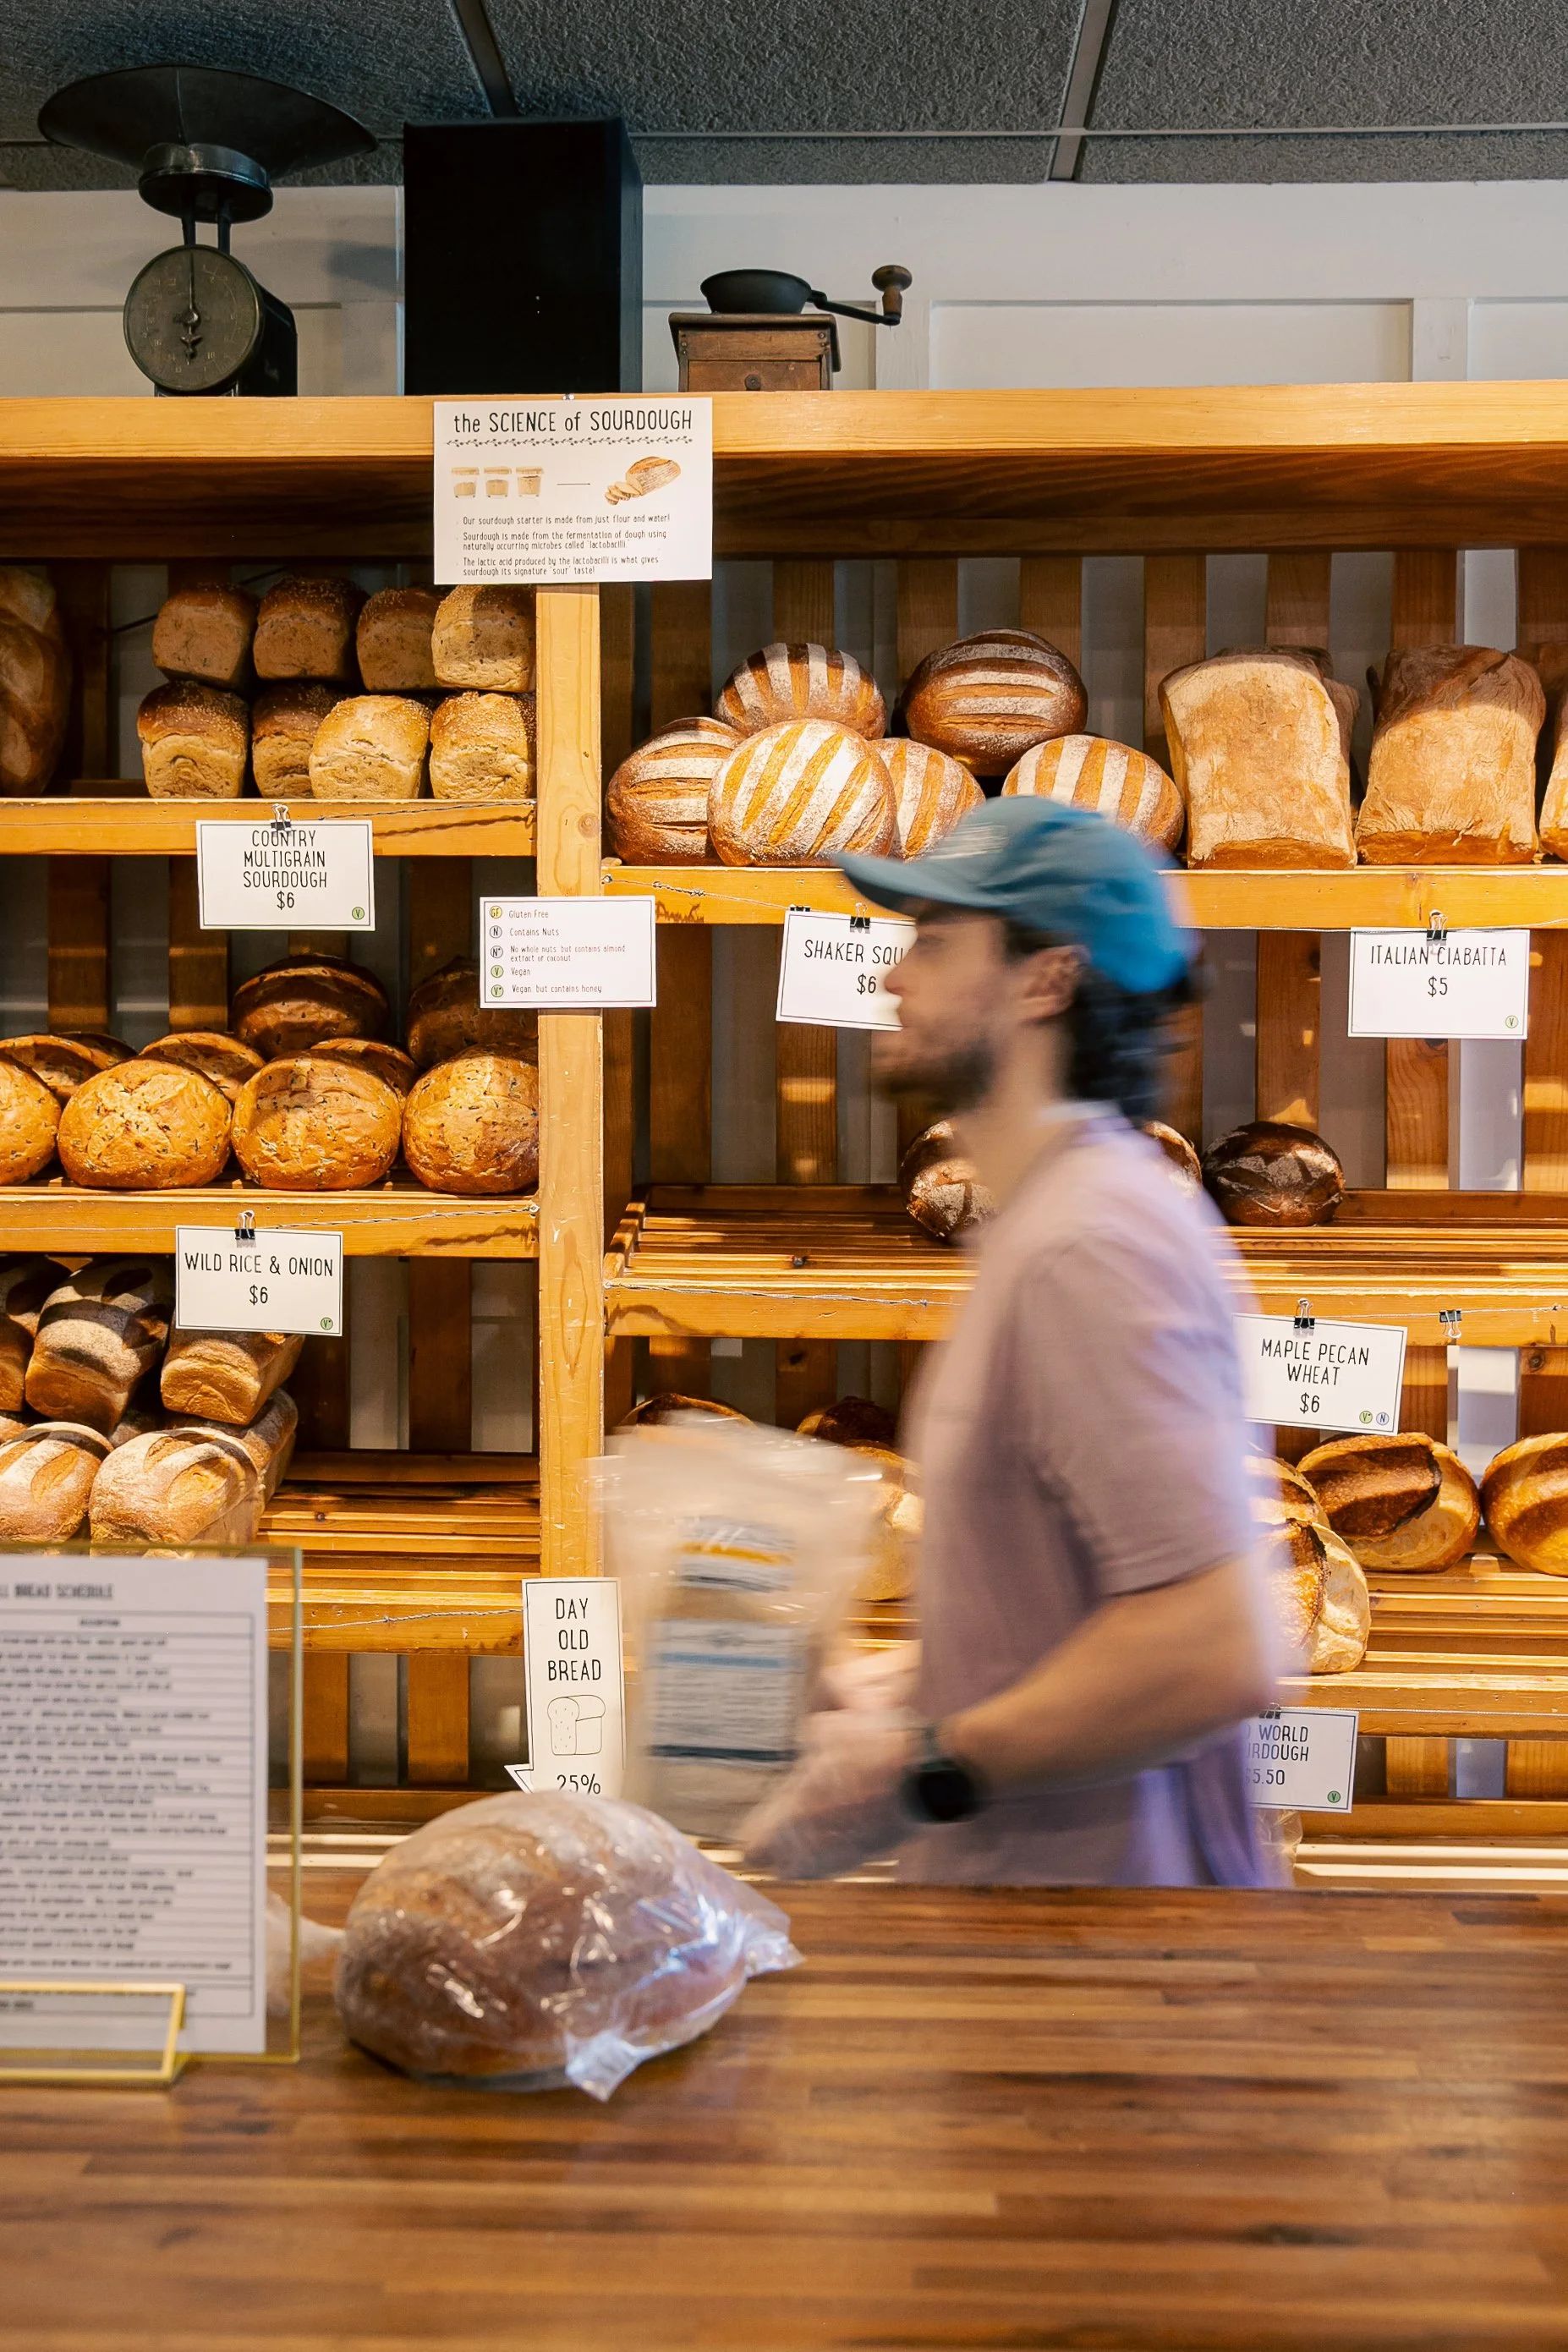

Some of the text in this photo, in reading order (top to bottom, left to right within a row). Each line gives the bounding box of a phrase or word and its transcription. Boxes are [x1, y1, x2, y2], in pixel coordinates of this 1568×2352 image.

[454, 409, 692, 433] the SCIENCE of SOURDOUGH
[463, 516, 475, 525] Our
[478, 516, 514, 525] sourdough
[546, 516, 551, 524] is
[555, 515, 573, 524] made
[576, 515, 593, 524] from
[595, 515, 610, 524] just
[613, 514, 630, 524] flour
[633, 513, 645, 523] and
[648, 513, 670, 522] water!
[463, 532, 500, 541] Sourdough
[511, 532, 529, 540] made
[567, 531, 612, 540] fermentation
[614, 530, 622, 539] of
[625, 530, 645, 540] dough
[648, 530, 666, 539] using
[463, 542, 494, 551] naturally
[496, 542, 529, 551] occurring
[531, 541, 562, 550] microbes
[564, 540, 584, 549] called
[463, 557, 474, 566] The
[499, 557, 513, 566] acid
[514, 557, 546, 567] produced
[548, 556, 556, 566] by
[559, 556, 570, 565] the
[573, 556, 609, 565] lactobacilli
[640, 556, 659, 565] gives
[463, 567, 499, 577] sourdough
[514, 567, 547, 577] signature
[574, 566, 595, 575] taste!
[252, 830, 316, 847] COUNTRY
[244, 851, 326, 868] MULTIGRAIN
[243, 870, 327, 888] SOURDOUGH
[277, 891, 295, 910] $6
[509, 910, 532, 918] Gluten
[535, 909, 549, 918] Free
[509, 928, 540, 936] Contains
[542, 928, 560, 936] Nuts
[521, 945, 539, 953] whole
[546, 954, 572, 962] coconut
[803, 939, 864, 963] SHAKER
[1370, 945, 1507, 966] ITALIAN CIABATTA
[511, 967, 531, 977] Vegan
[535, 984, 548, 993] but
[551, 984, 579, 994] contains
[581, 984, 602, 994] honey
[857, 973, 877, 995] $6
[1428, 976, 1449, 997] $5
[184, 1253, 333, 1277] WILD RICE & ONION
[249, 1284, 269, 1306] $6
[1261, 1338, 1369, 1366] MAPLE PECAN
[1287, 1363, 1340, 1386] WHEAT
[1299, 1392, 1321, 1414] $6
[555, 1598, 589, 1620] DAY
[558, 1629, 589, 1650] OLD
[547, 1658, 602, 1681] BREAD
[1258, 1724, 1309, 1742] WORLD
[556, 1773, 601, 1795] 25%
